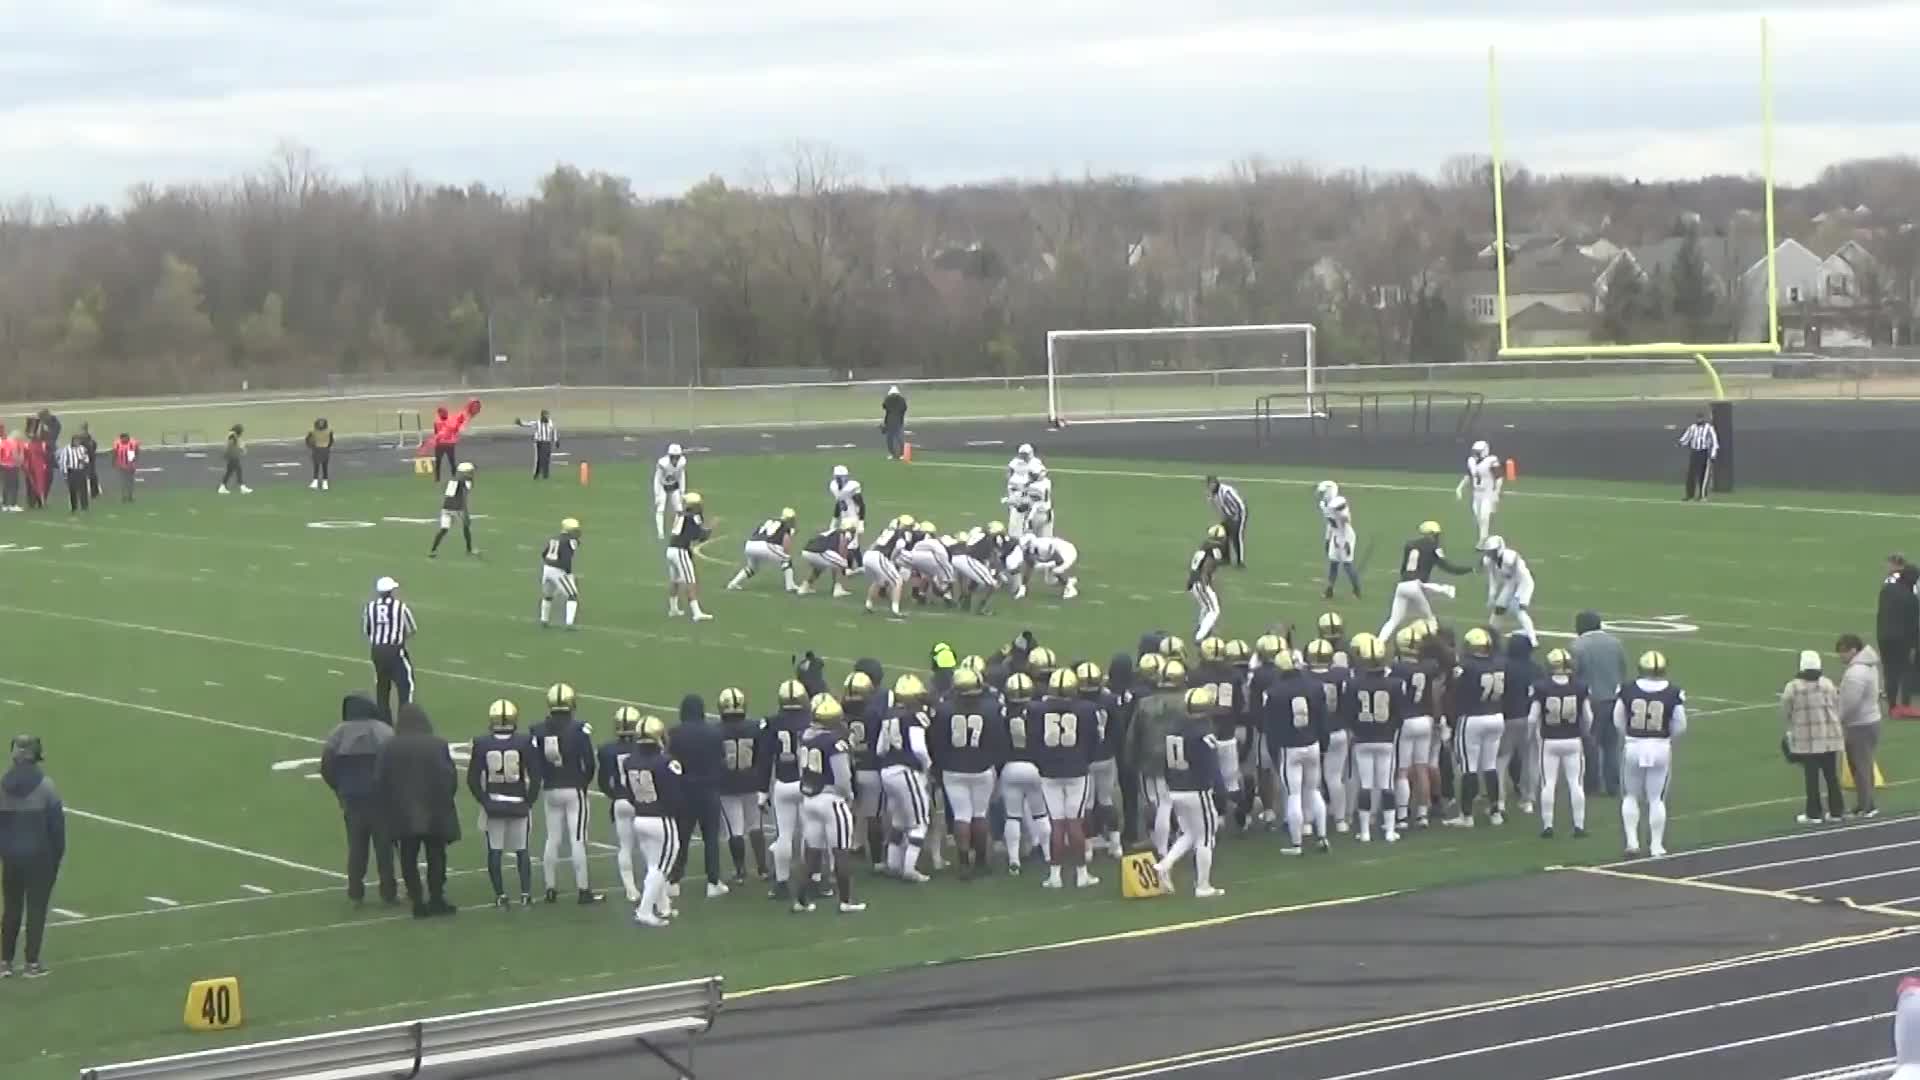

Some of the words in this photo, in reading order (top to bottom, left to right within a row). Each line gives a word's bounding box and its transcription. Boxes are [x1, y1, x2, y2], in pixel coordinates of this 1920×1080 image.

[376, 603, 390, 622] R
[1132, 858, 1160, 890] 30
[202, 984, 231, 1025] 40
